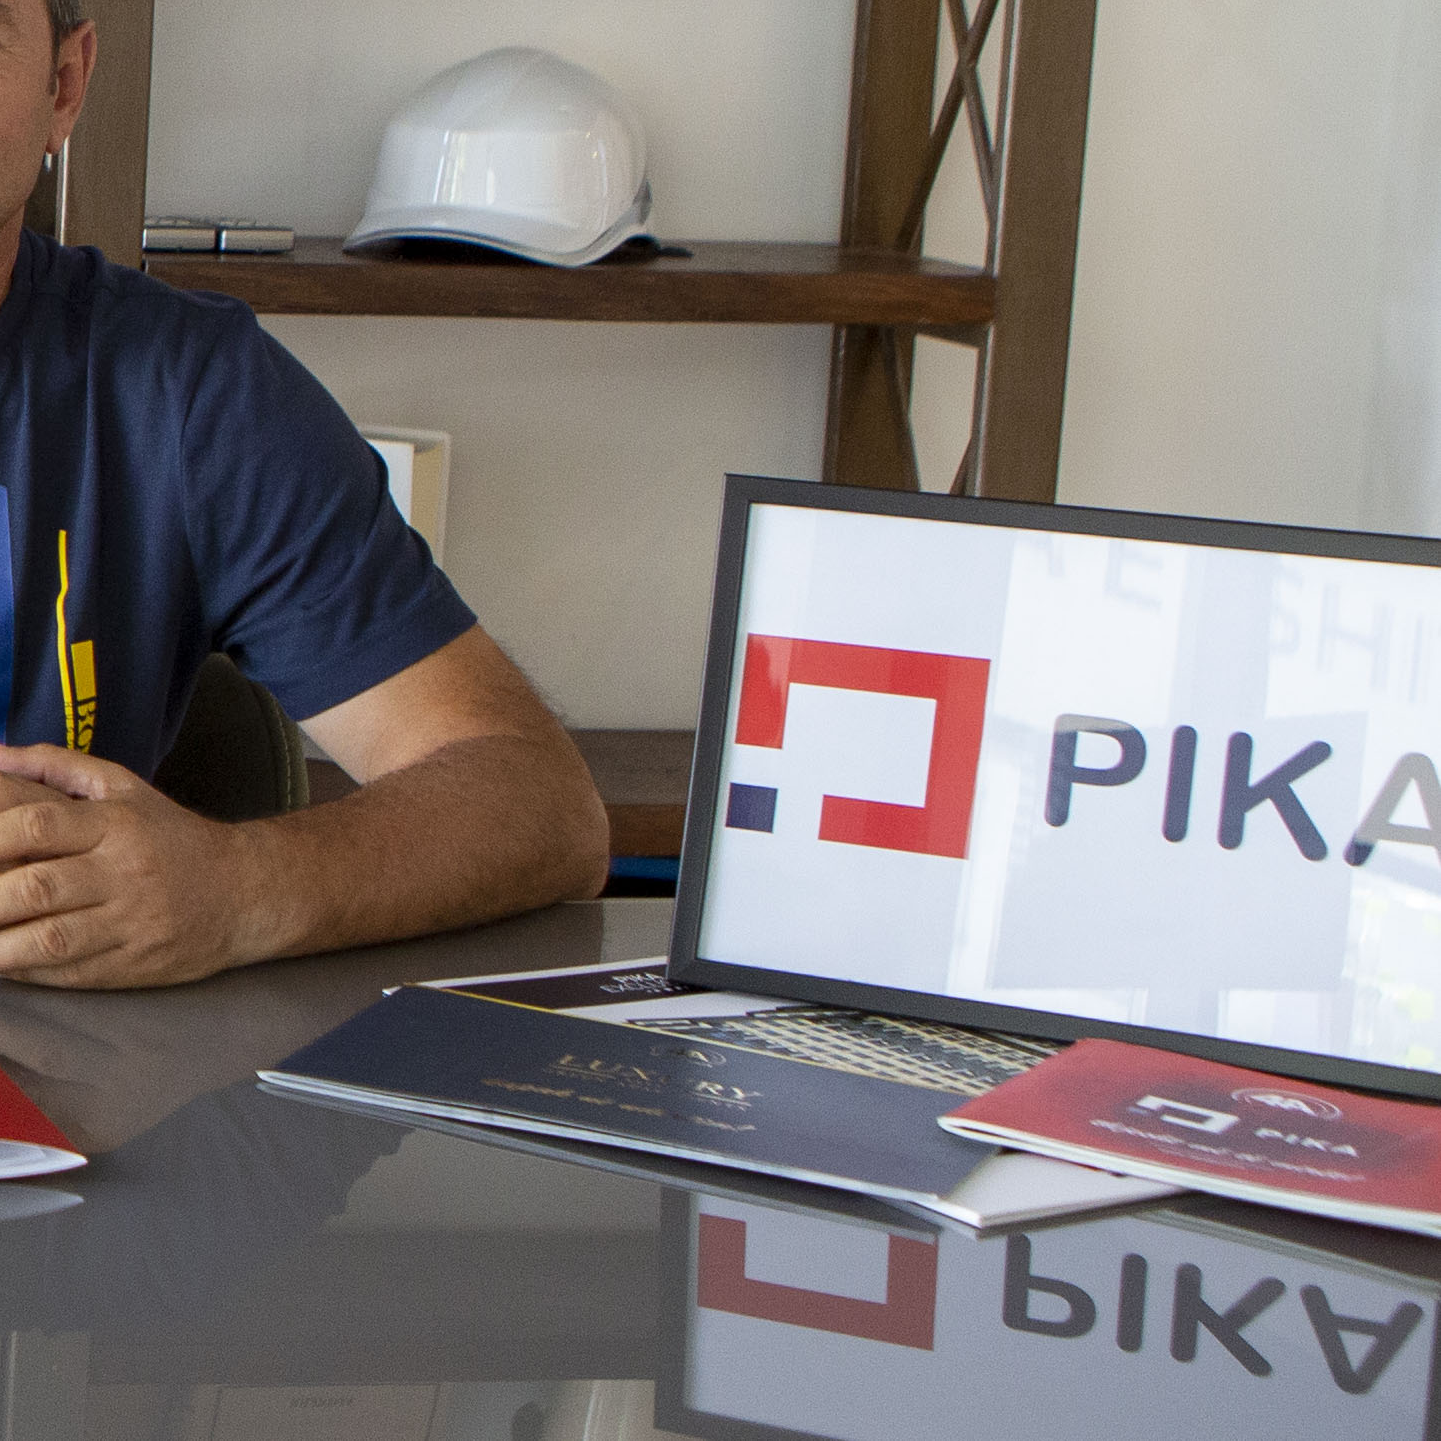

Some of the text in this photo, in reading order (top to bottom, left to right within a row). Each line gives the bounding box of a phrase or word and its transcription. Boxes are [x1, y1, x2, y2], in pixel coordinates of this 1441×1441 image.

[1044, 713, 1441, 868] PIKA
[559, 1054, 764, 1101] LUXRY
[1252, 1126, 1360, 1159] PIKA
